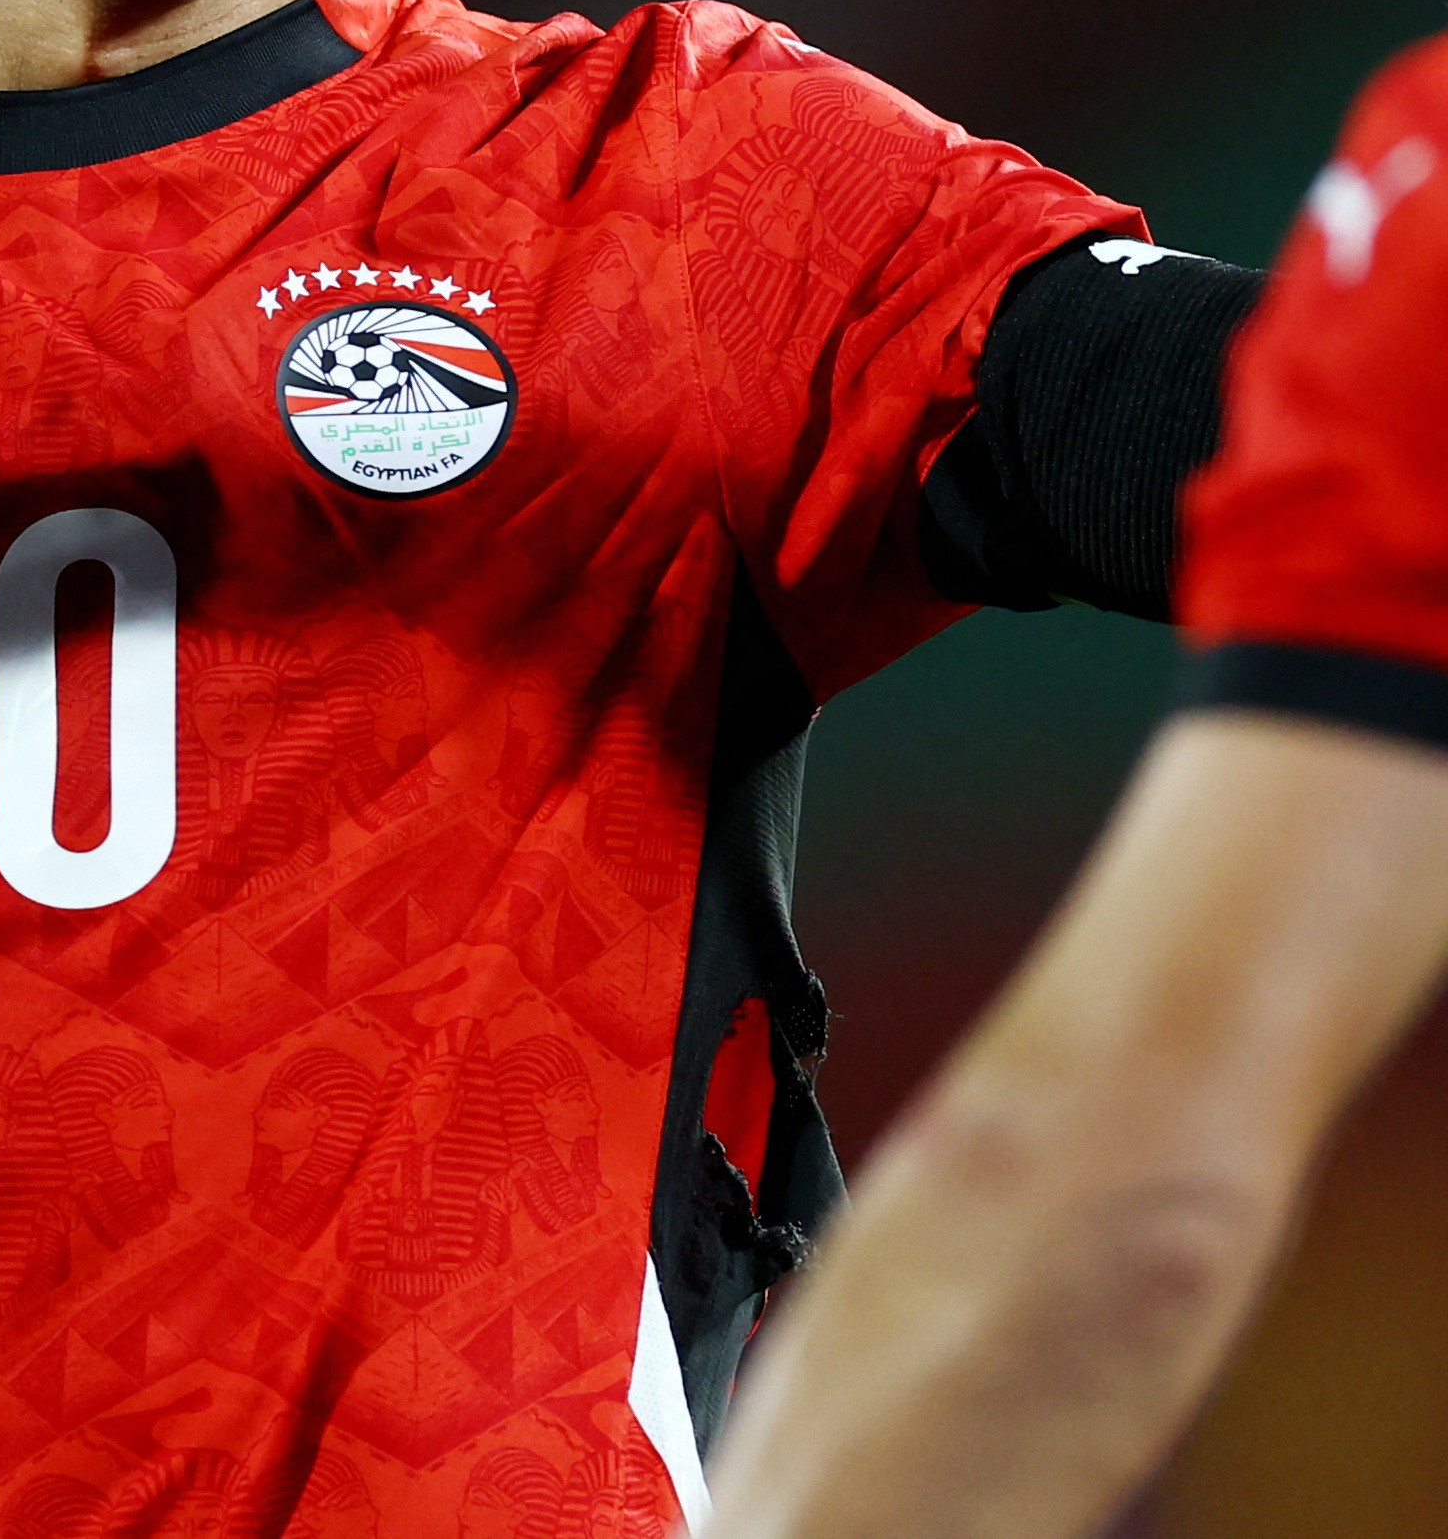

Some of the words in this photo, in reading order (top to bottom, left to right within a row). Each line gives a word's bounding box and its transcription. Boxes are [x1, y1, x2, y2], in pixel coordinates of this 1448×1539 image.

[320, 416, 406, 442] المصري
[418, 409, 484, 432] الاتحاد
[340, 436, 402, 463] القدم
[412, 430, 471, 457] لكرة
[351, 460, 440, 481] EGYPTIAN
[441, 452, 464, 469] FA
